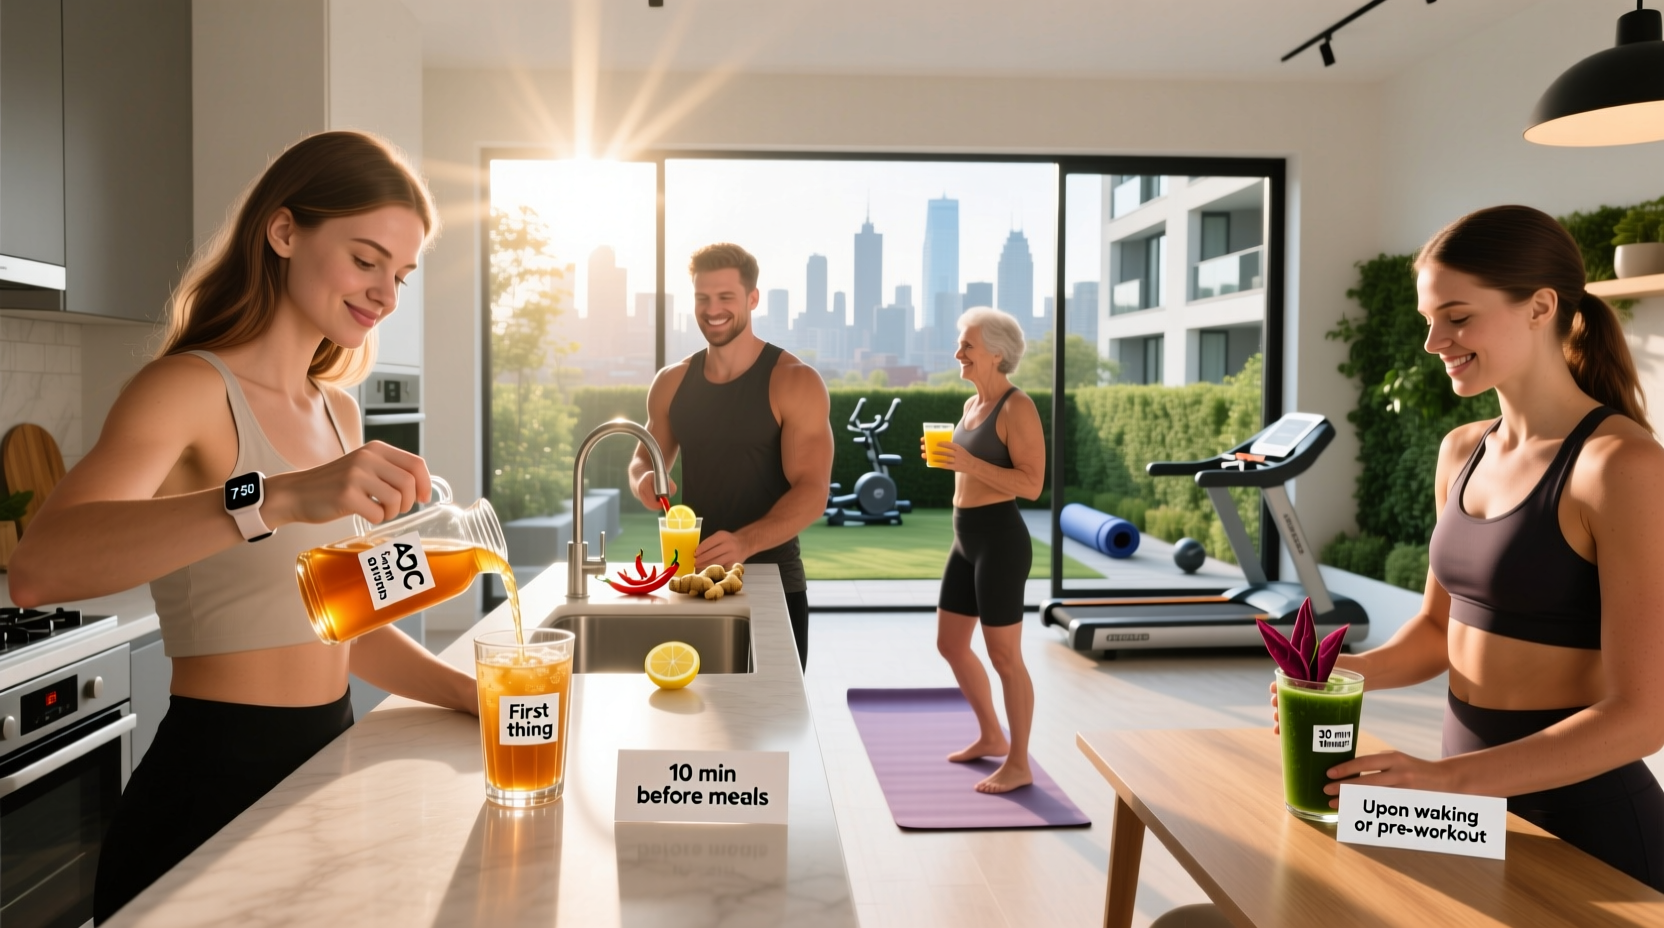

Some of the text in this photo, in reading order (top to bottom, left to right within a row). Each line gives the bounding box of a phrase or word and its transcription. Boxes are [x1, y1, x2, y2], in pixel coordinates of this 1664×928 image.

[509, 703, 549, 719] First
[506, 721, 553, 740] thing
[669, 763, 737, 782] 10 min
[637, 785, 769, 806] before meals
[1363, 799, 1479, 827] Upon waking
[1354, 820, 1487, 843] or pre-workout
